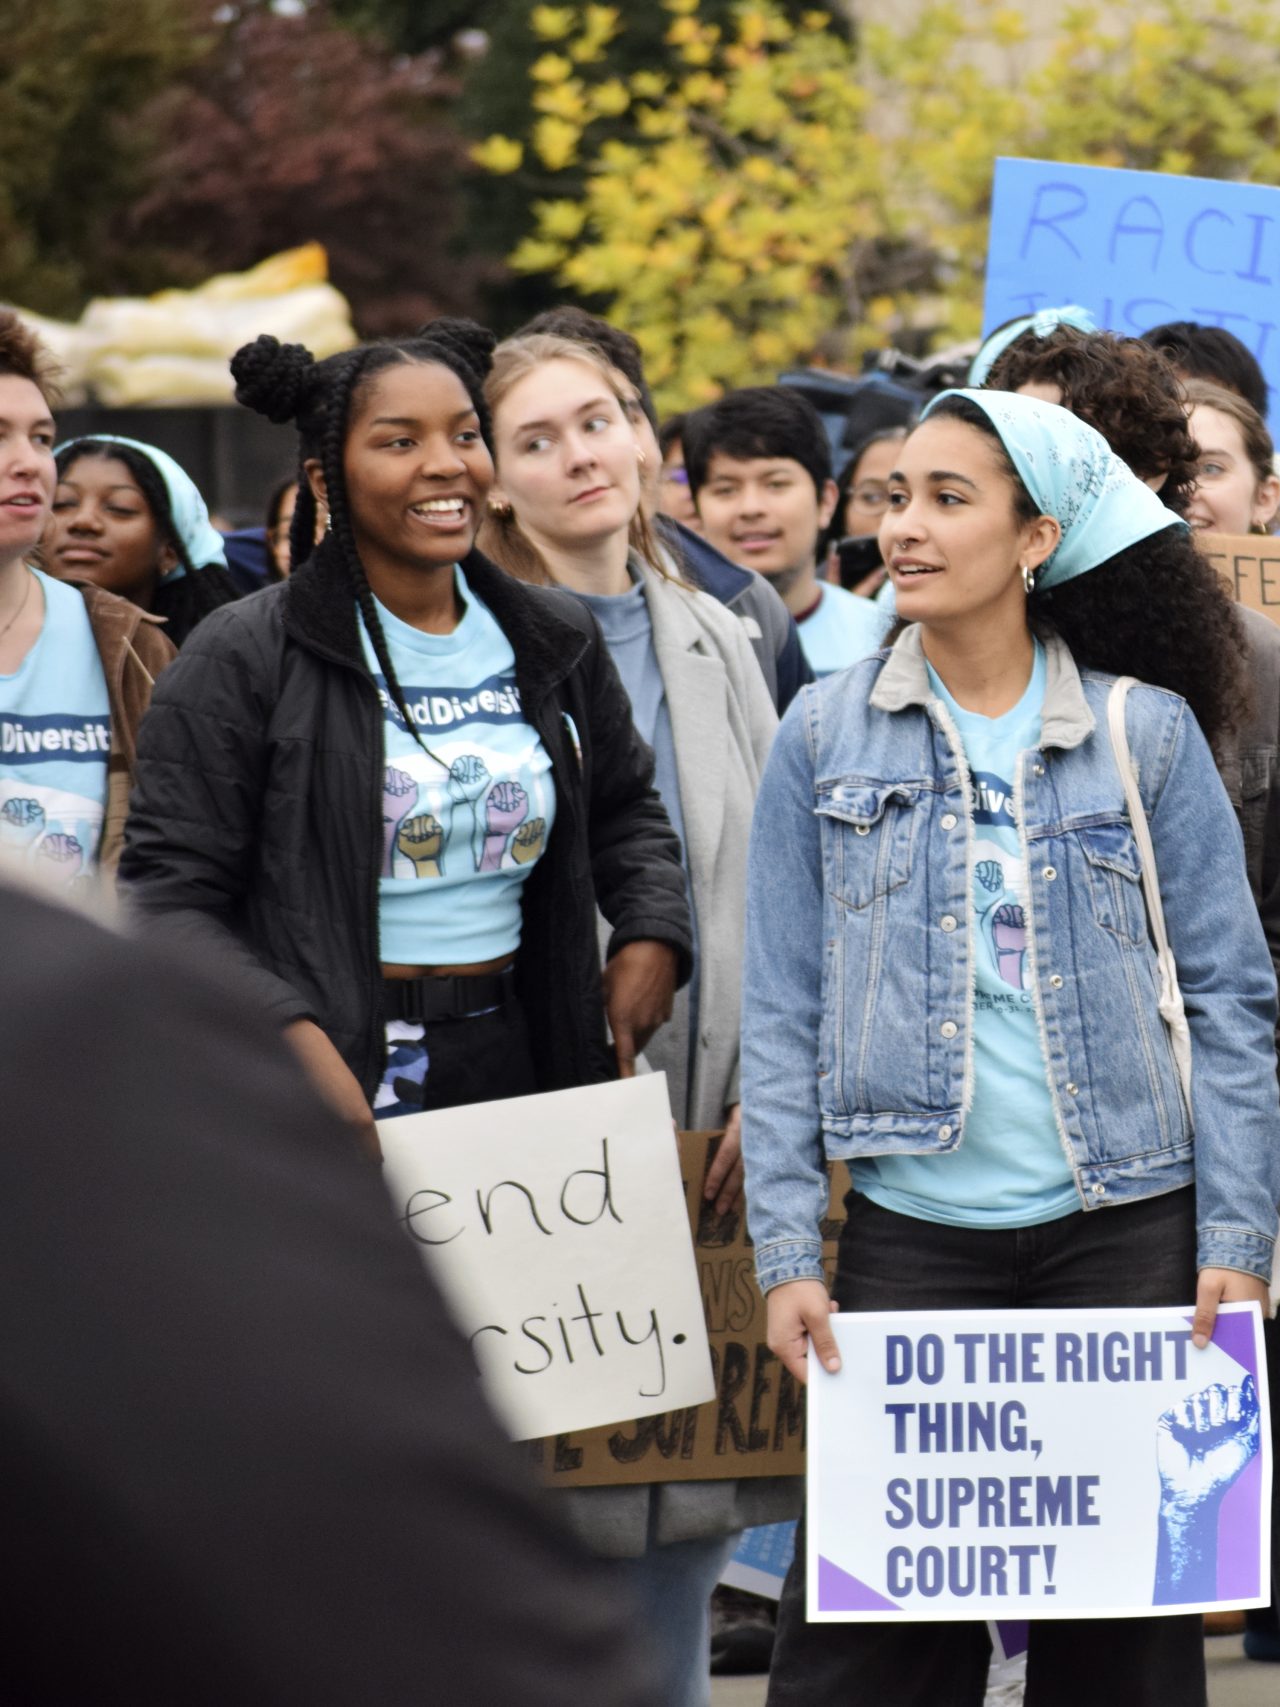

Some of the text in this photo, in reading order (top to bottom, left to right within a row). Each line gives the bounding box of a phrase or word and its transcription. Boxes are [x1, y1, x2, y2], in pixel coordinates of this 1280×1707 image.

[2, 721, 112, 753] Diversit
[885, 1330, 1194, 1386] DO THE RIGHT
[885, 1400, 1043, 1461] THING,
[885, 1475, 1101, 1529] SUPREME
[885, 1544, 1057, 1598] COURT!
